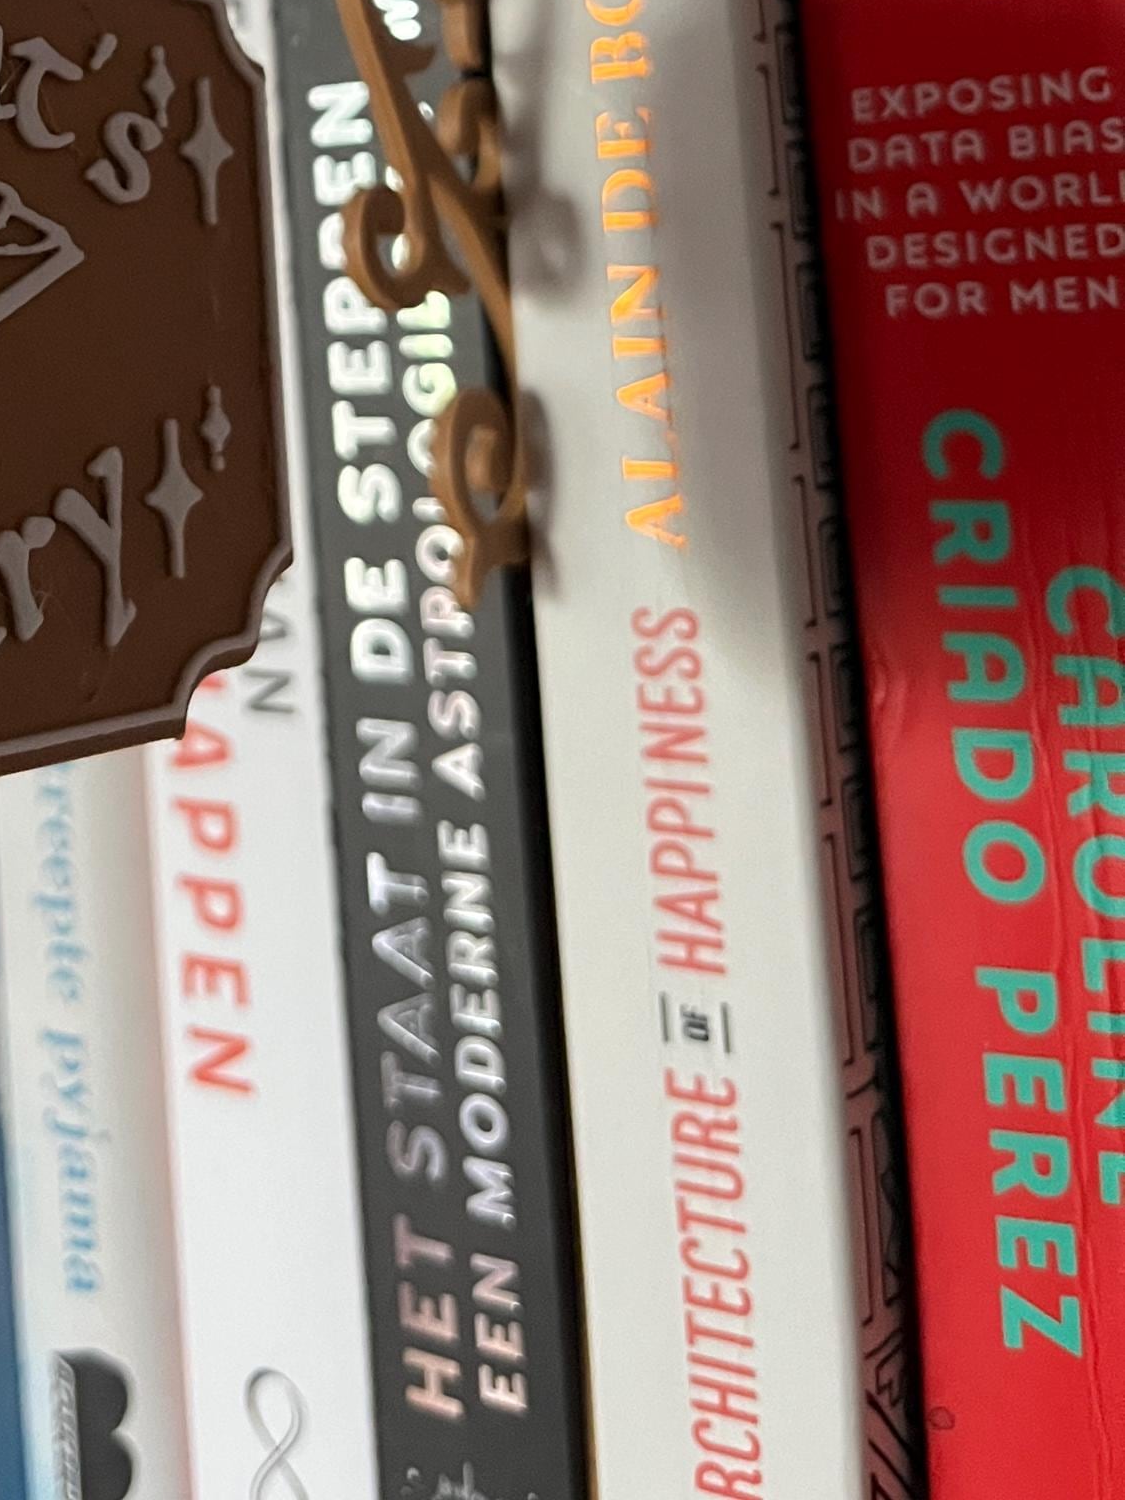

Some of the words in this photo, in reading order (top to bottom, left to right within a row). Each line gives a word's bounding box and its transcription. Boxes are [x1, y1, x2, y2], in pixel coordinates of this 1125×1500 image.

[596, 106, 656, 233] DE
[834, 186, 884, 221] IN
[906, 182, 939, 217] A
[959, 170, 1125, 213] WORL
[846, 129, 986, 173] DATA
[1008, 116, 1125, 160] BIAS
[851, 66, 1113, 123] EXPOSING
[865, 223, 1125, 270] DESIGNED
[885, 282, 987, 318] FOR
[1009, 274, 1120, 313] MEN
[606, 263, 686, 551] ALAIN
[343, 556, 411, 685] DE
[921, 407, 1049, 904] CRIADO
[357, 716, 421, 825] IN
[631, 605, 729, 975] HAPPINESS
[33, 764, 92, 1004] reepte
[169, 674, 257, 1096] APPEN
[366, 853, 450, 1184] STAAT
[437, 821, 515, 1227] MODERNE
[40, 1029, 104, 1293] pyjama
[975, 966, 1084, 1359] PEREZ
[391, 1212, 466, 1421] HET
[472, 1255, 529, 1414] EEN
[664, 1065, 765, 1500] RCHITECTURE
